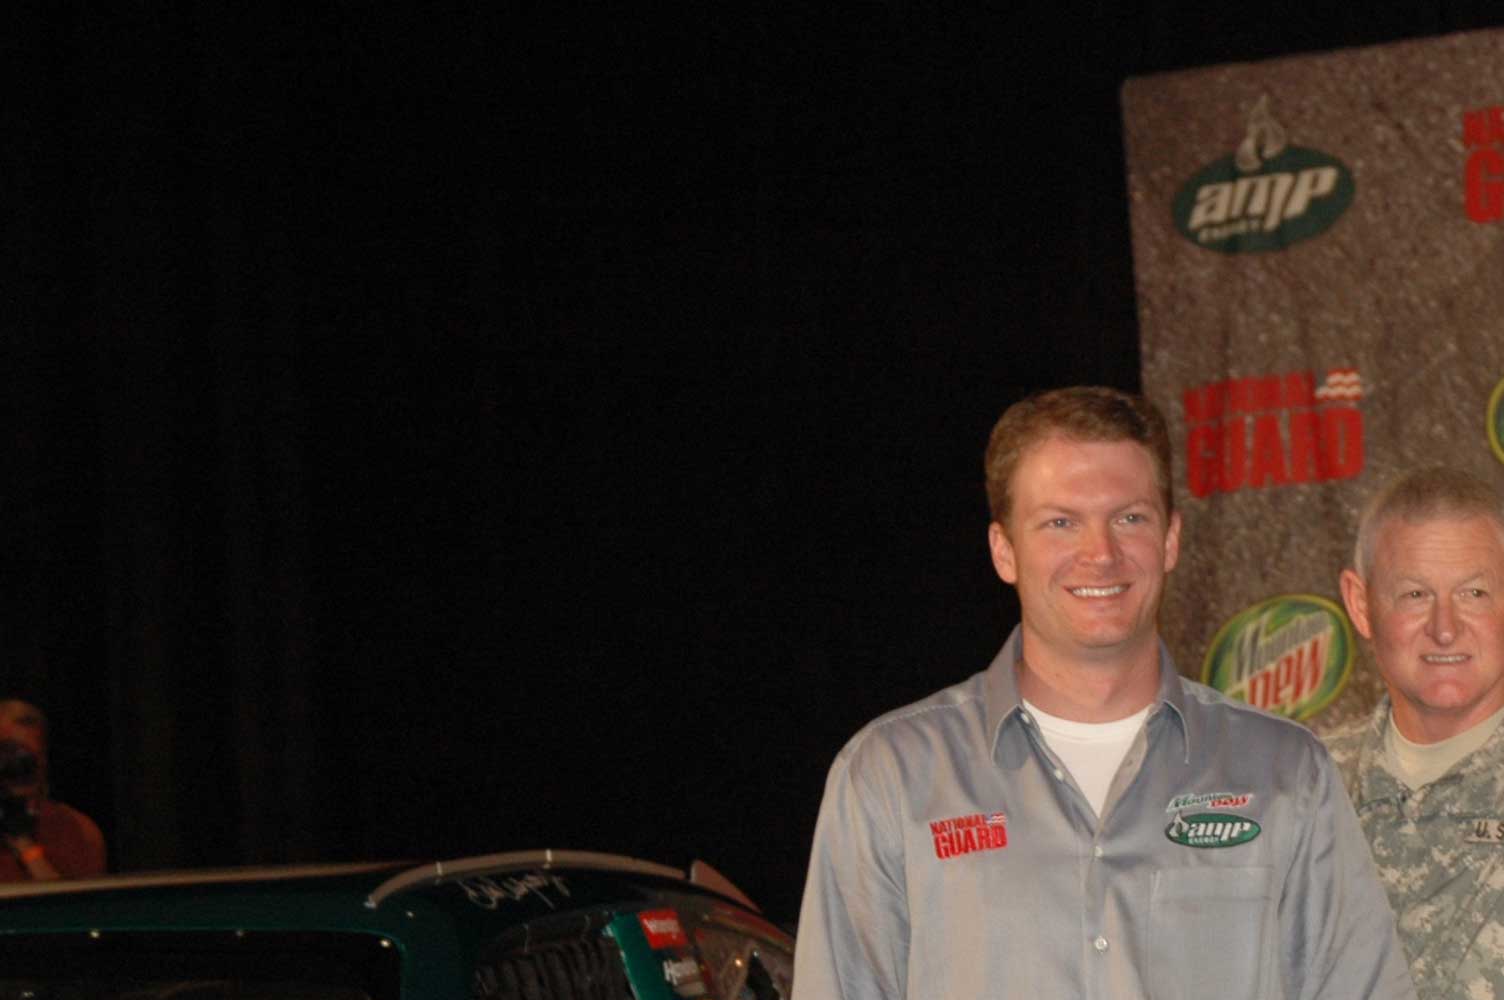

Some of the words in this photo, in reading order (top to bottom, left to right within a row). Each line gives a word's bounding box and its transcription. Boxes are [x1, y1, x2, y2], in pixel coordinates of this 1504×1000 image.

[1184, 371, 1315, 420] NATIONAL
[1186, 406, 1364, 498] GUARD
[930, 813, 987, 834] NATIONAL
[933, 825, 1008, 860] GUARD
